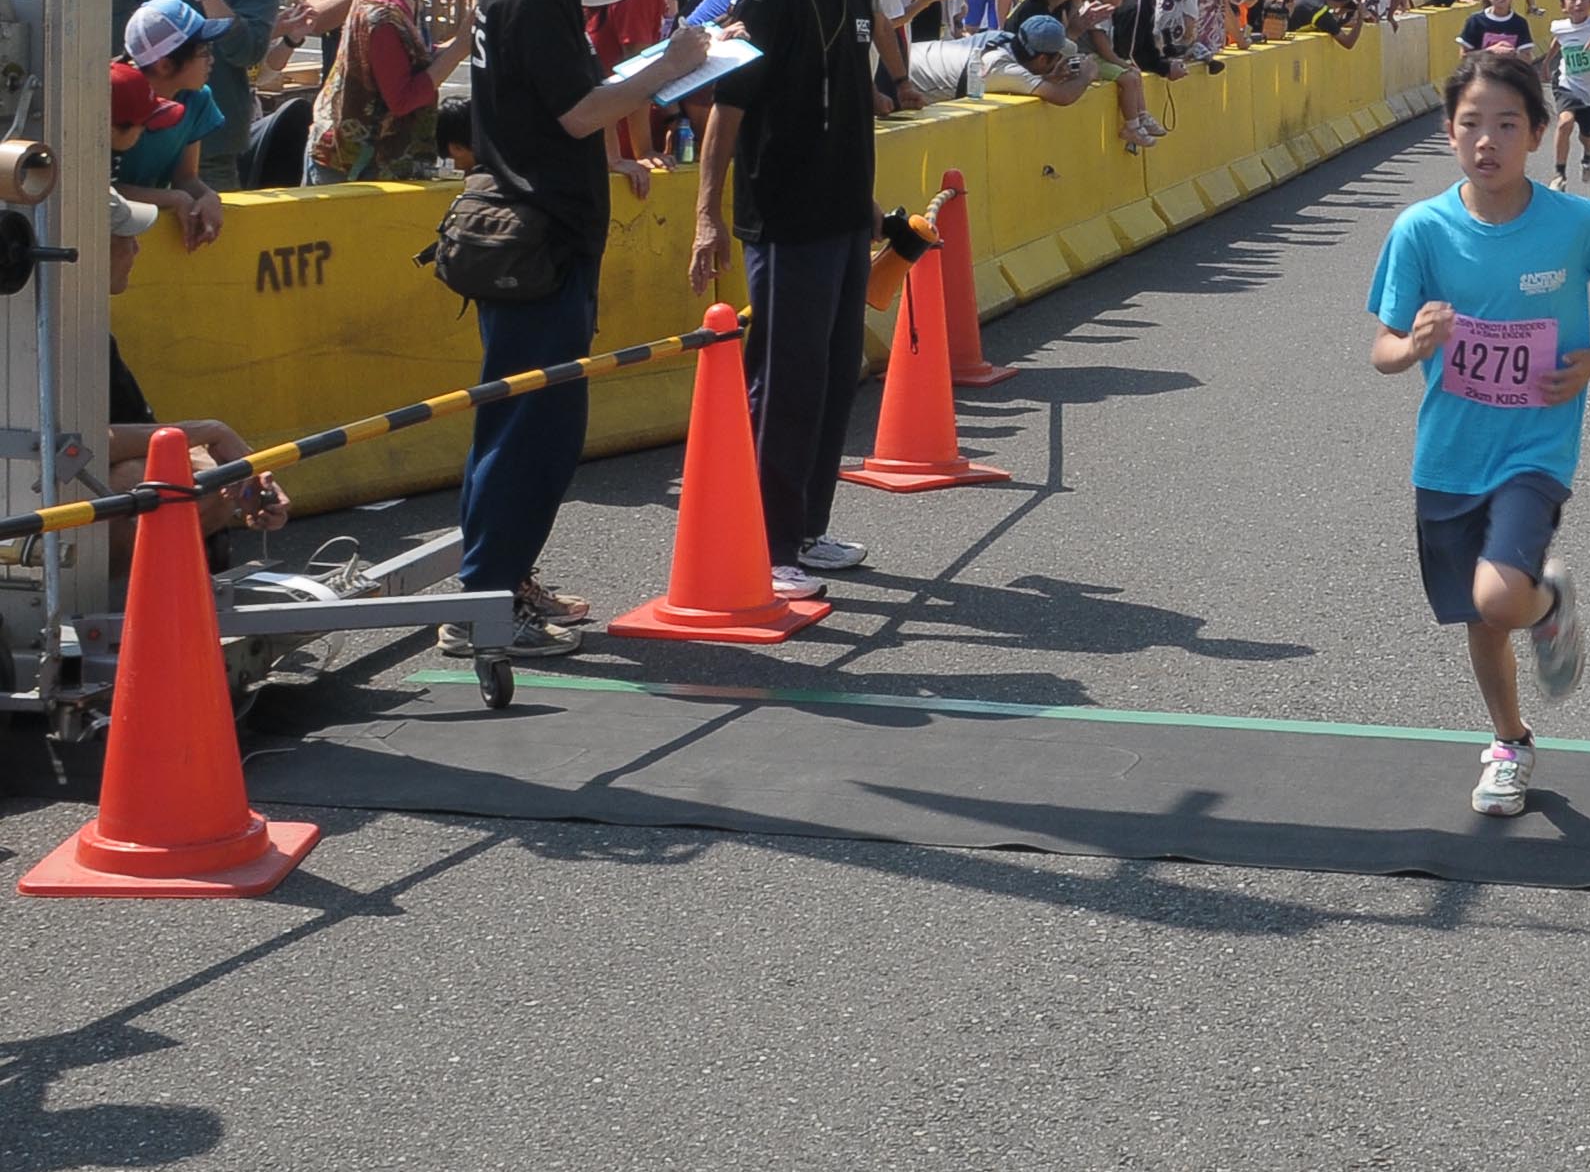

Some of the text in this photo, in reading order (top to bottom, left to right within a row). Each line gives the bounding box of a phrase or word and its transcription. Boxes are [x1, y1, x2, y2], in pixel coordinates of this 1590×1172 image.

[1451, 339, 1530, 385] 4279
[1465, 387, 1529, 405] 2km KIDS
